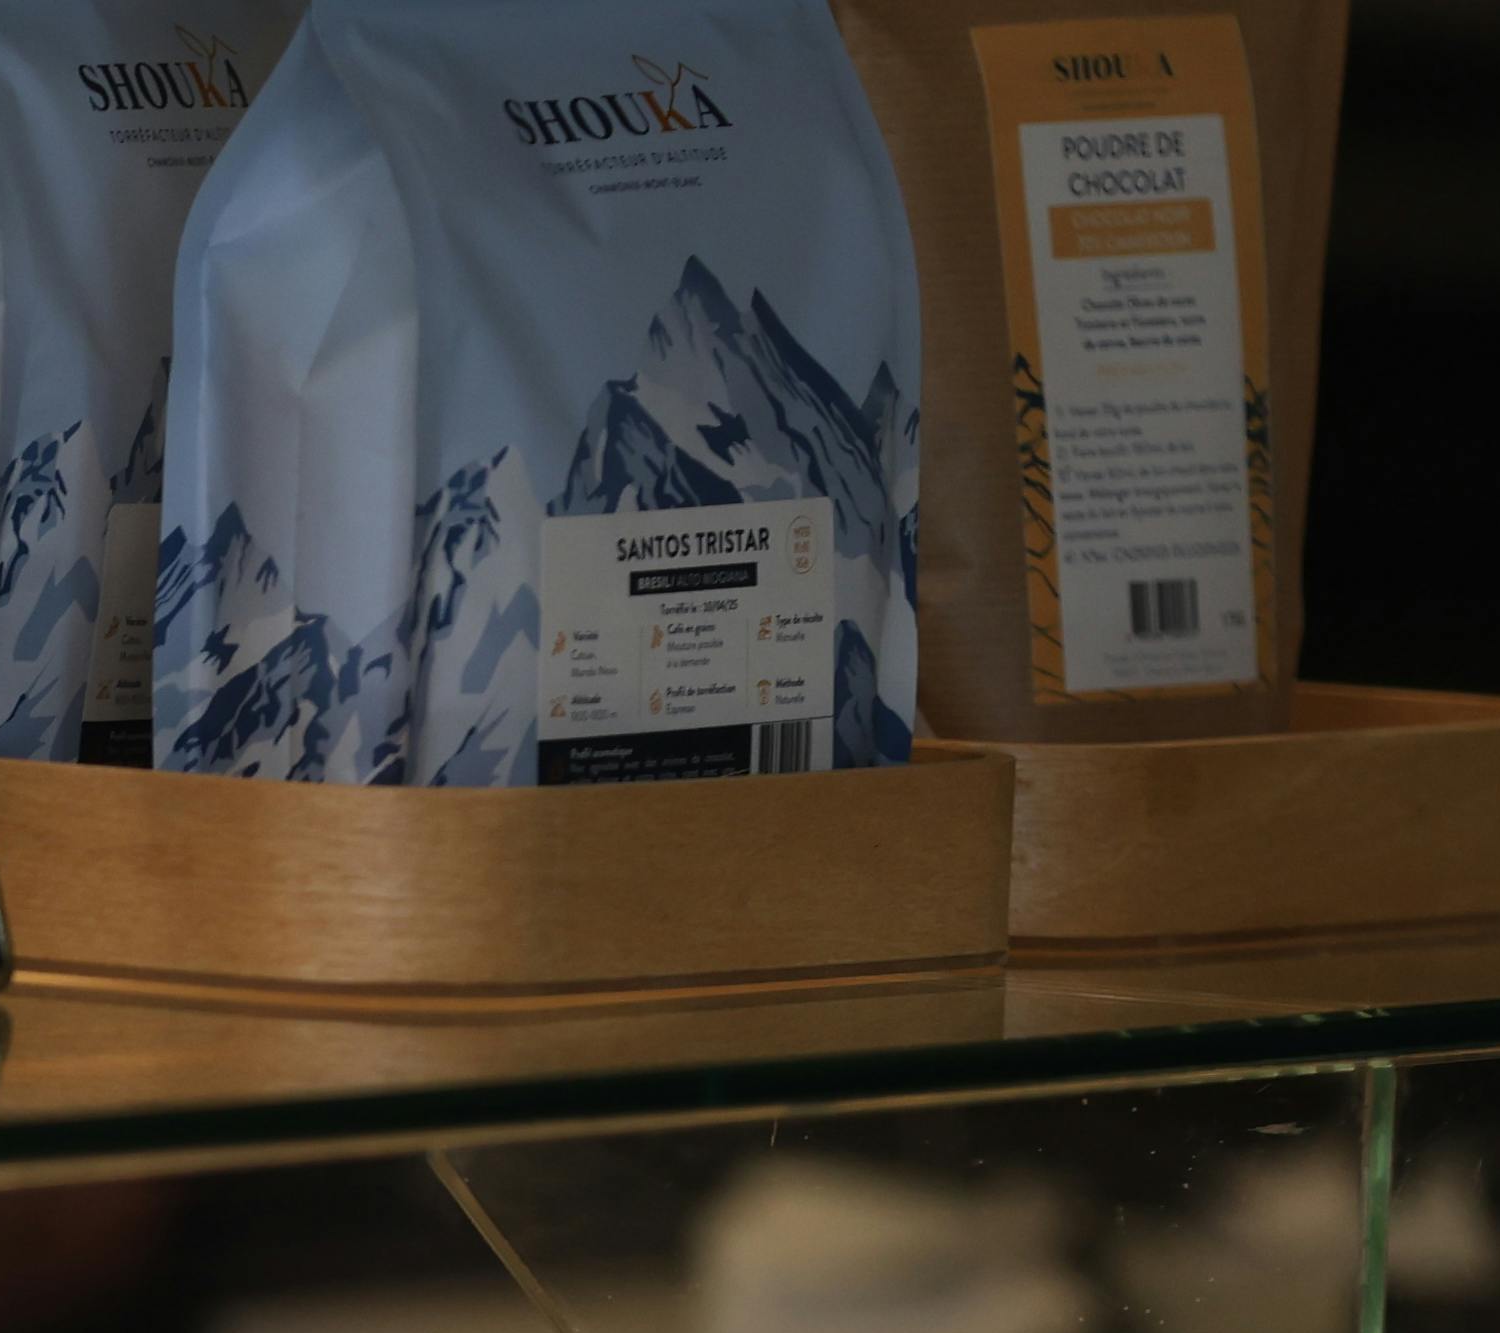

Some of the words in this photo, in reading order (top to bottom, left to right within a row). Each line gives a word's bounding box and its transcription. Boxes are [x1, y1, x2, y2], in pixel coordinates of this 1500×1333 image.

[78, 58, 249, 111] SHOUKA
[503, 84, 733, 145] SHOUKA
[1061, 131, 1152, 160] POUDRE
[1156, 130, 1186, 157] DE
[1067, 168, 1186, 197] CHOCOLAT
[616, 533, 690, 561] SANTOS
[695, 527, 771, 555] TRISTAR
